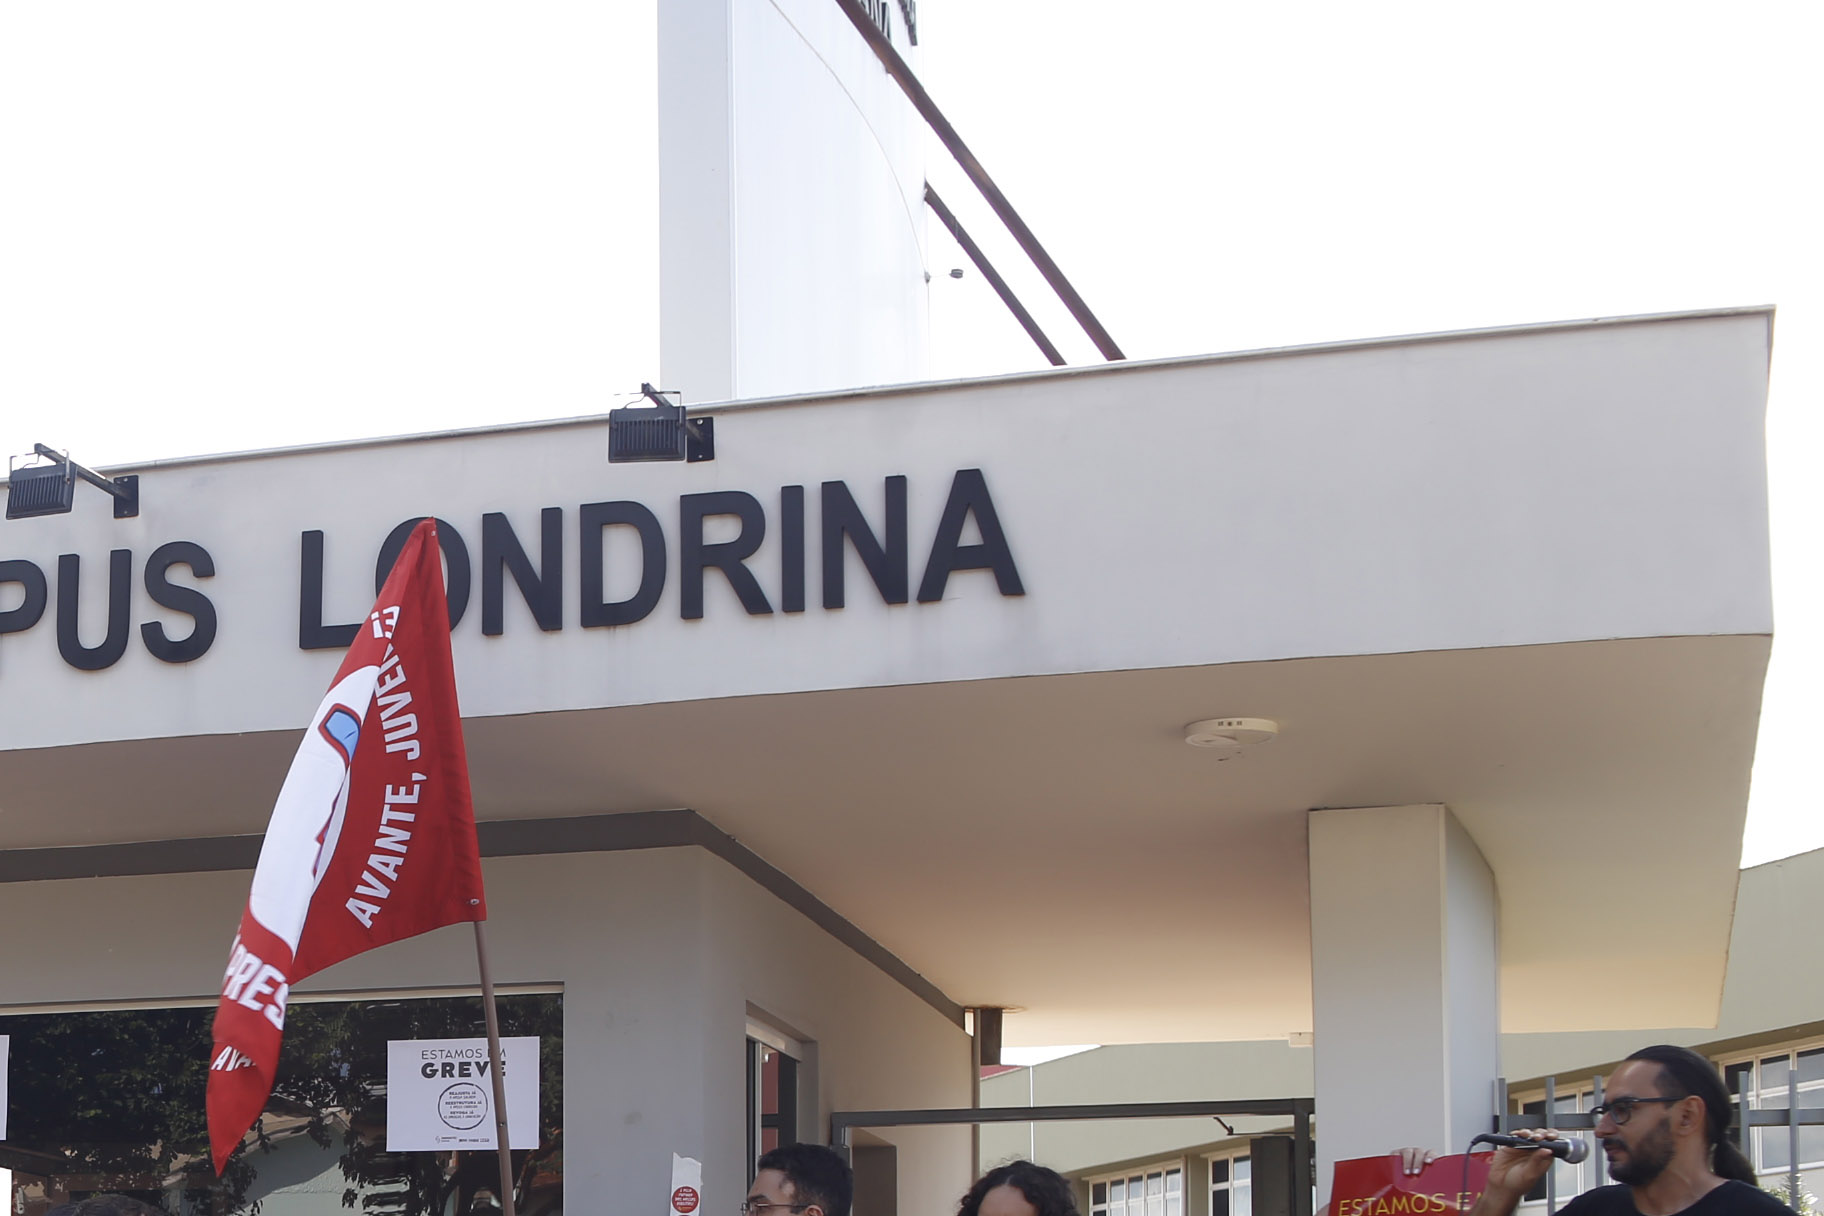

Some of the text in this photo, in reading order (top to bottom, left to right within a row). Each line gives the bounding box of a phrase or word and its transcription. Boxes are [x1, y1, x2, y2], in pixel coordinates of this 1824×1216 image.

[299, 468, 1026, 650] LONDRINA
[345, 771, 428, 929] AVANTE,
[422, 1049, 482, 1060] ESTAMOS
[1456, 1191, 1483, 1211] E
